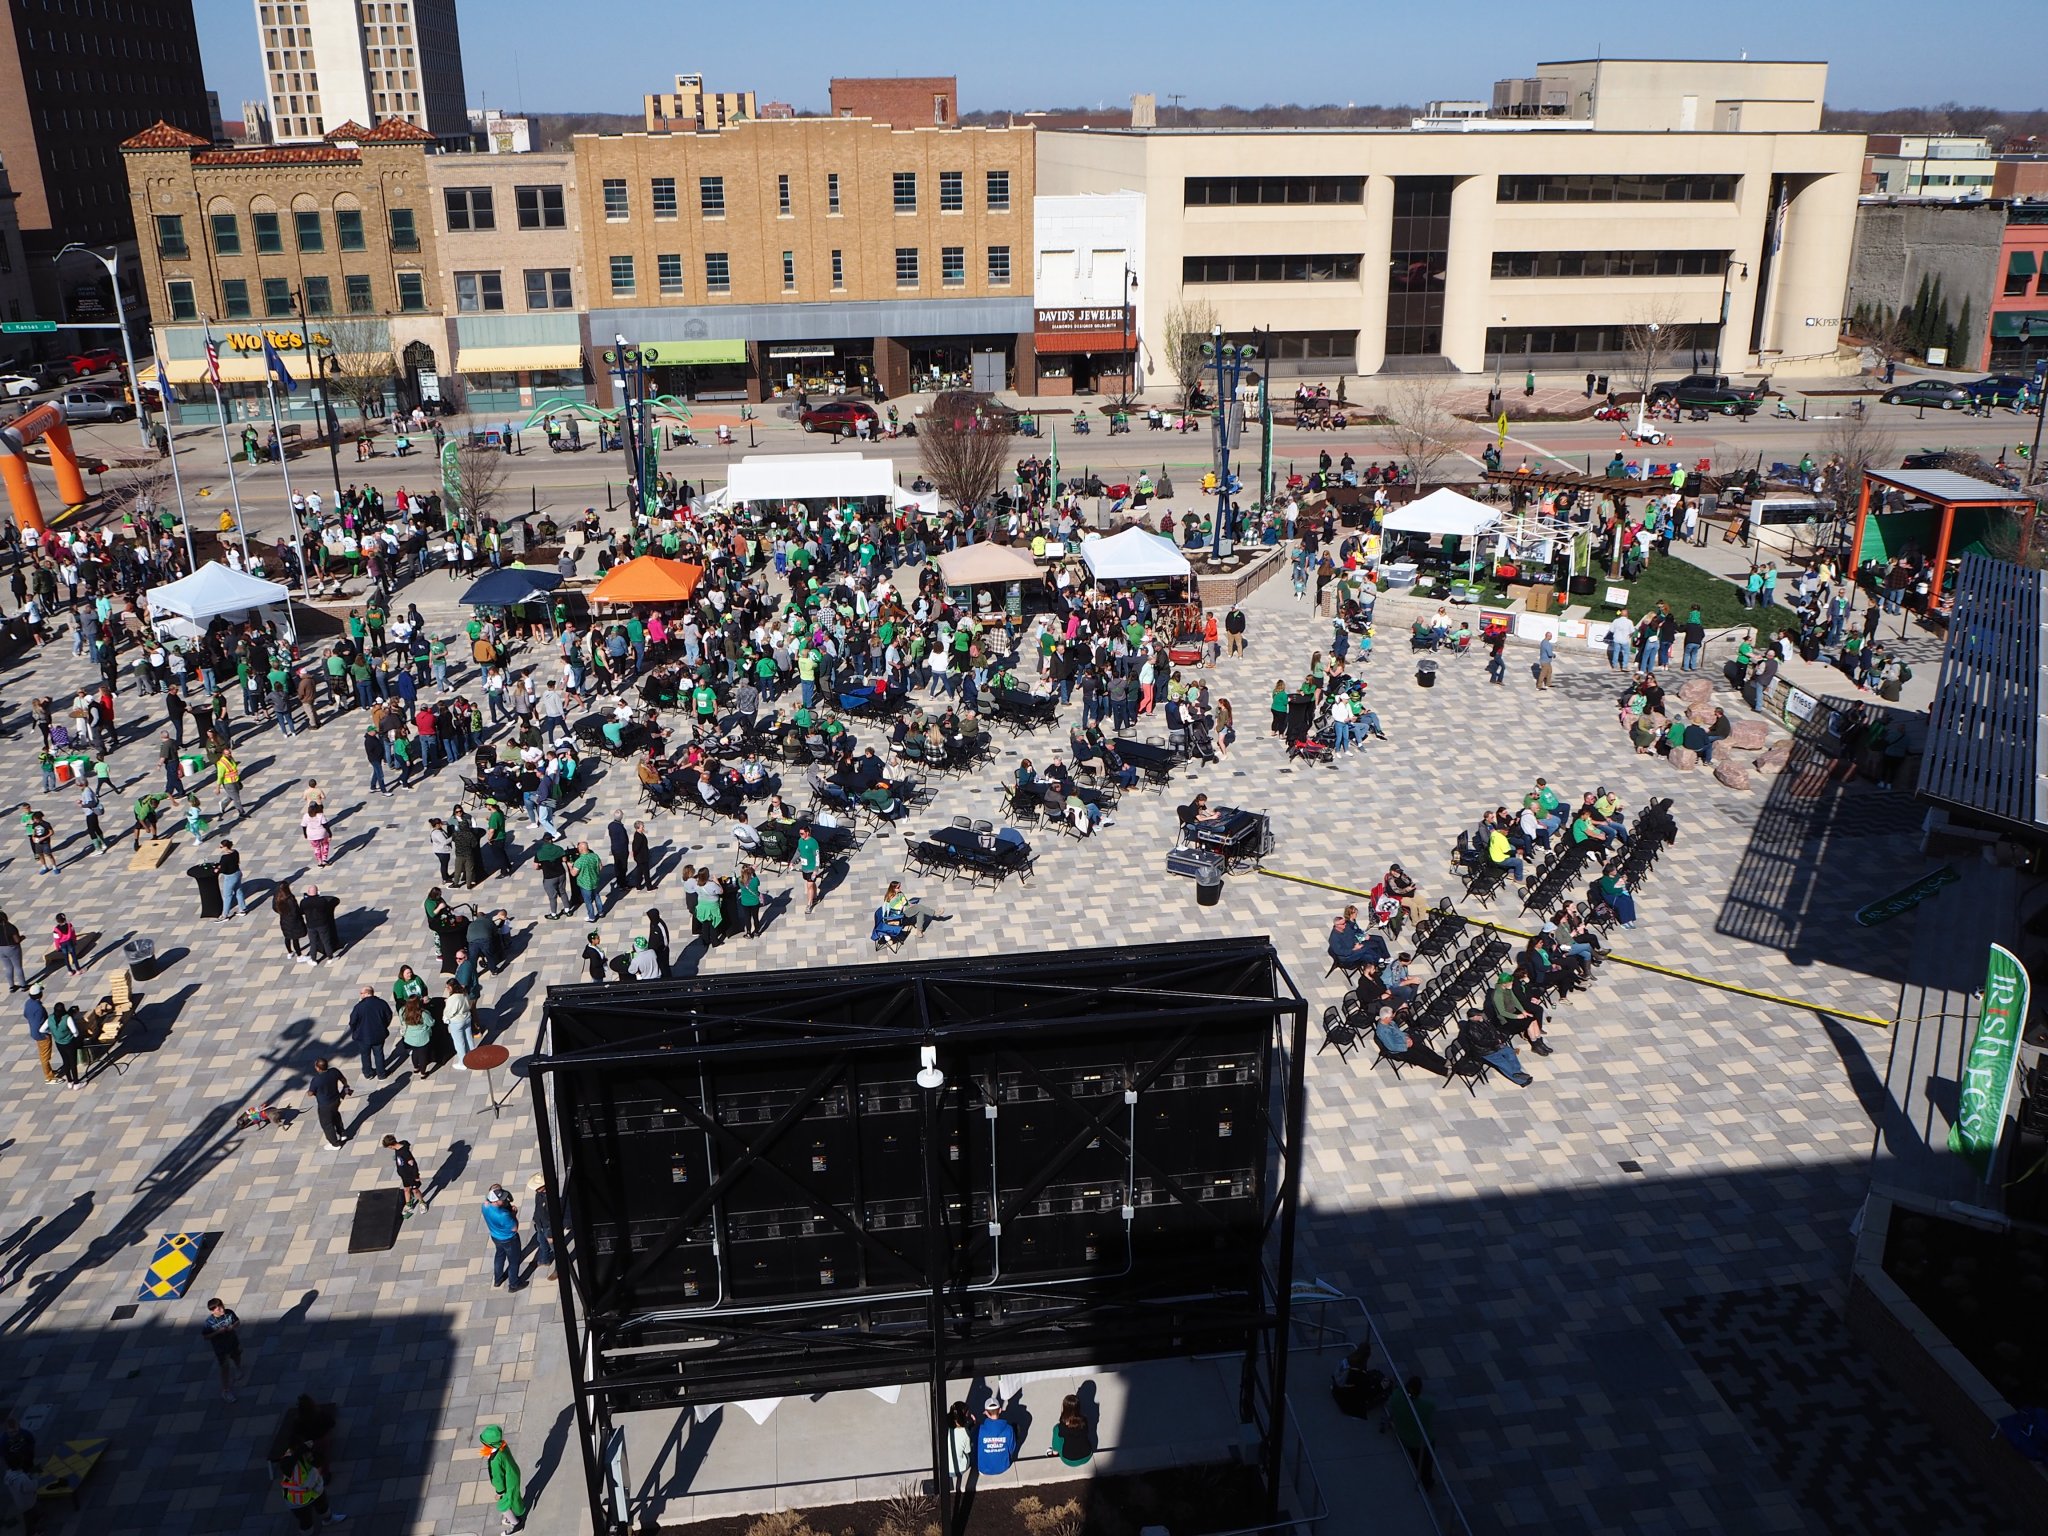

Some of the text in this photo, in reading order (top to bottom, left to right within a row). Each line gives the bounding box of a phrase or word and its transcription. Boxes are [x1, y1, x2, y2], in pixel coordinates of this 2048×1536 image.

[1039, 310, 1130, 322] DAVID'S JEWELER
[225, 329, 302, 351] Wofe's
